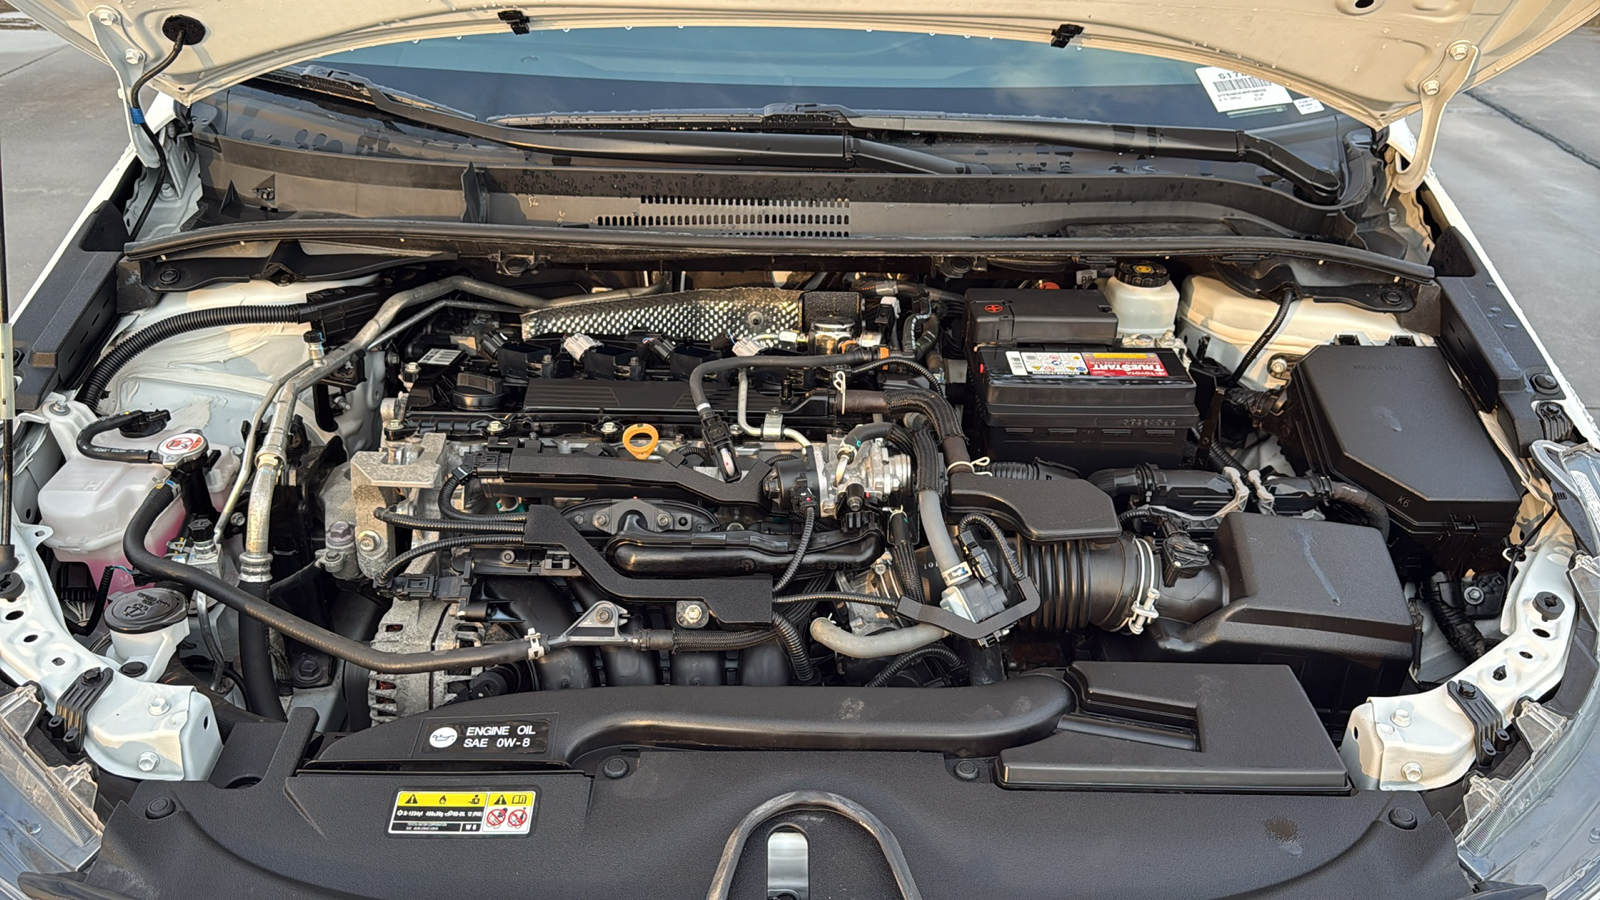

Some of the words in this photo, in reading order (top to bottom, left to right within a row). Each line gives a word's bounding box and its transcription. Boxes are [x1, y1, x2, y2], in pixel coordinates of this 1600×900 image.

[1397, 495, 1411, 508] K6
[466, 726, 510, 736] ENGINE
[516, 725, 536, 735] OIL
[463, 739, 488, 748] SAE
[496, 738, 530, 748] 0W-8
